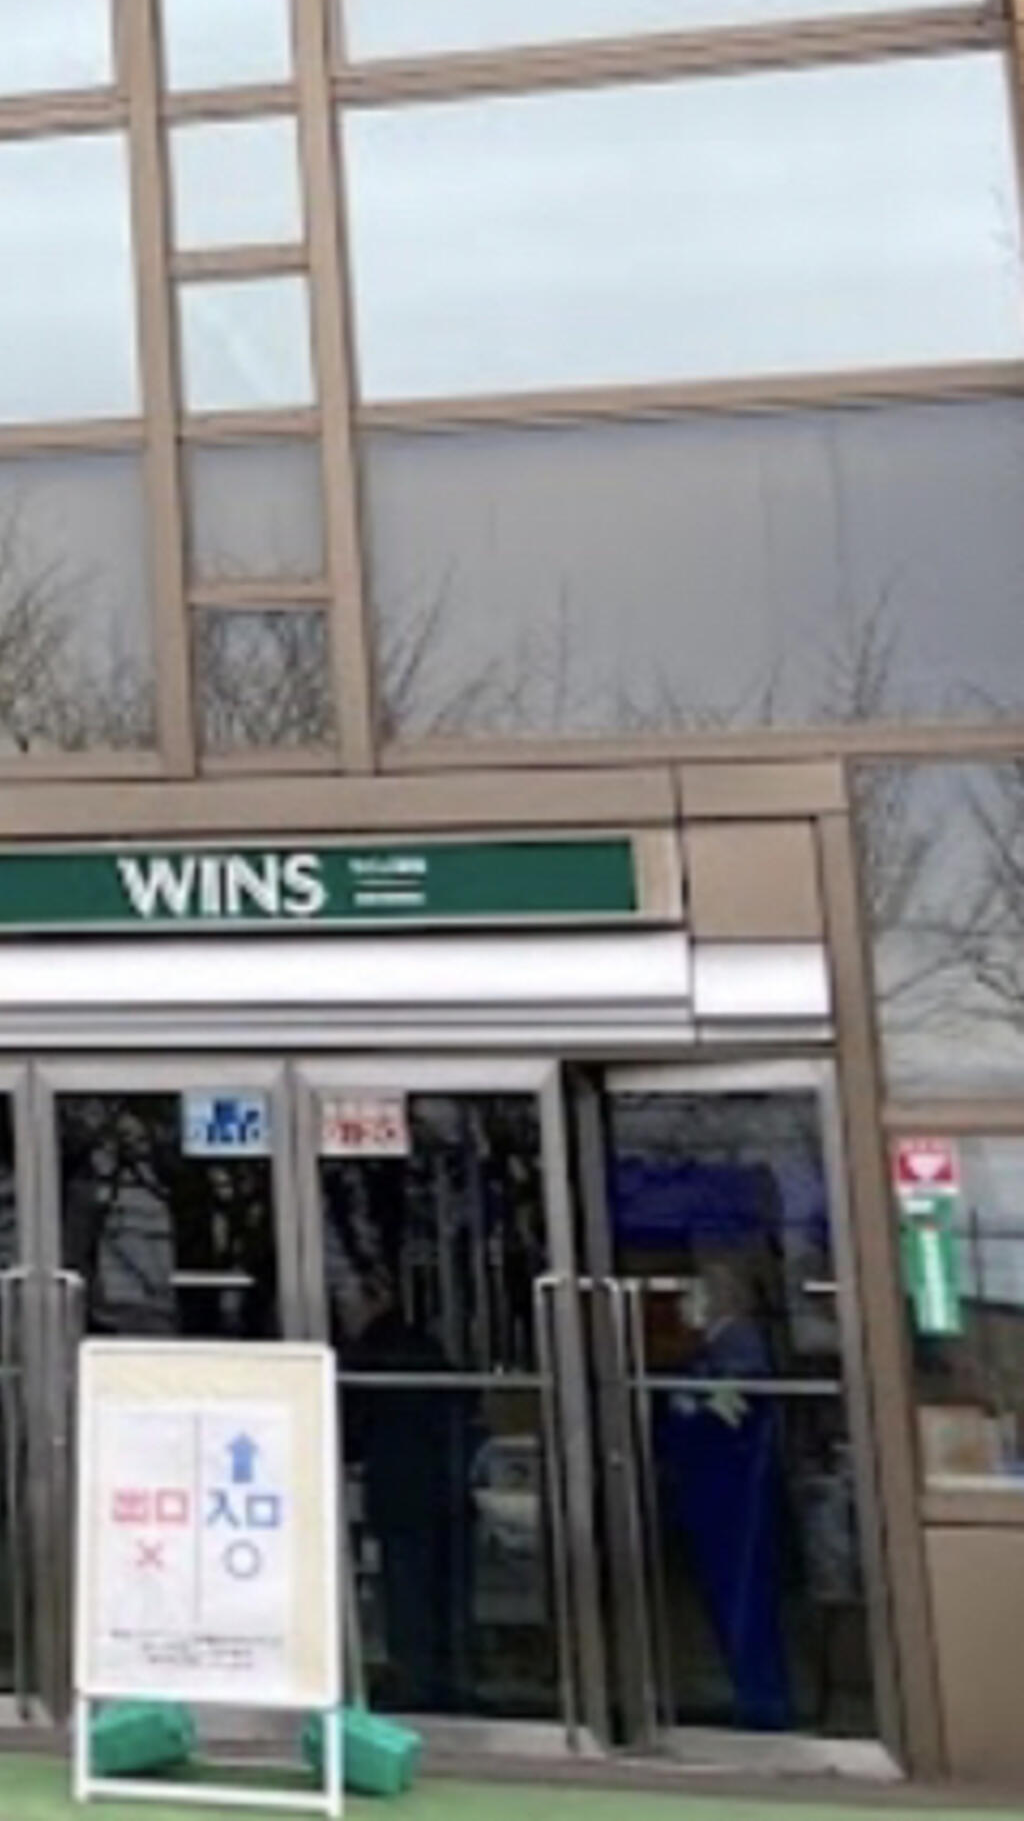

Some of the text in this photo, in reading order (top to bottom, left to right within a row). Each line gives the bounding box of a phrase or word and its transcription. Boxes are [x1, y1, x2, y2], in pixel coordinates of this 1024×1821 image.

[117, 854, 328, 916] WINS
[111, 1488, 191, 1524] 出口
[204, 1488, 281, 1529] 入口
